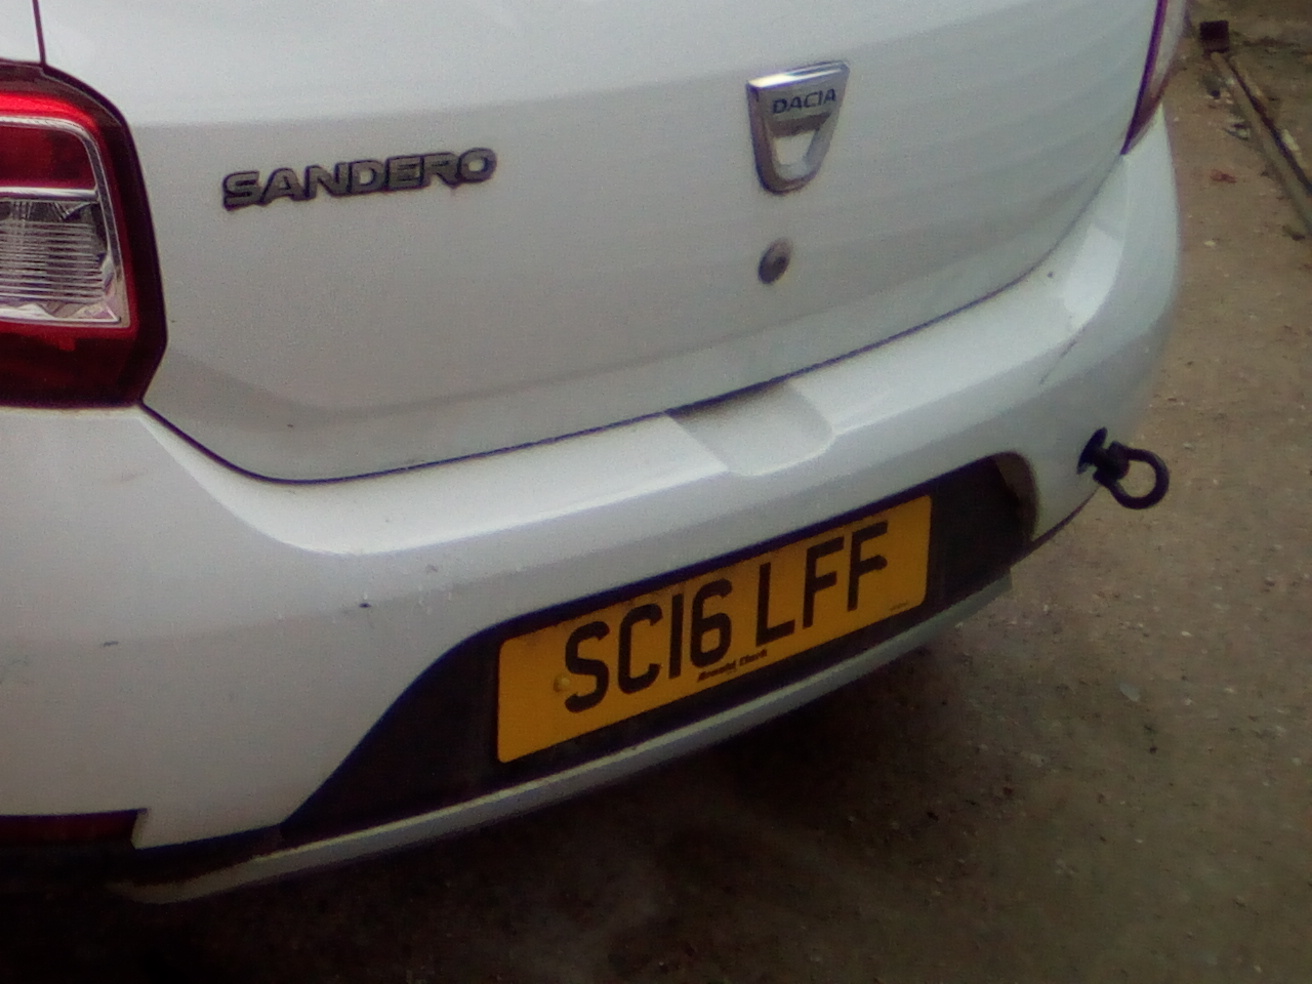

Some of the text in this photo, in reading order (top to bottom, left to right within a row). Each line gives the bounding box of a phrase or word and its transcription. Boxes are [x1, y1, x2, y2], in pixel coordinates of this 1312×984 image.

[772, 88, 837, 114] DACIA
[222, 147, 497, 211] SANDERO
[564, 521, 888, 713] SC16 LFF
